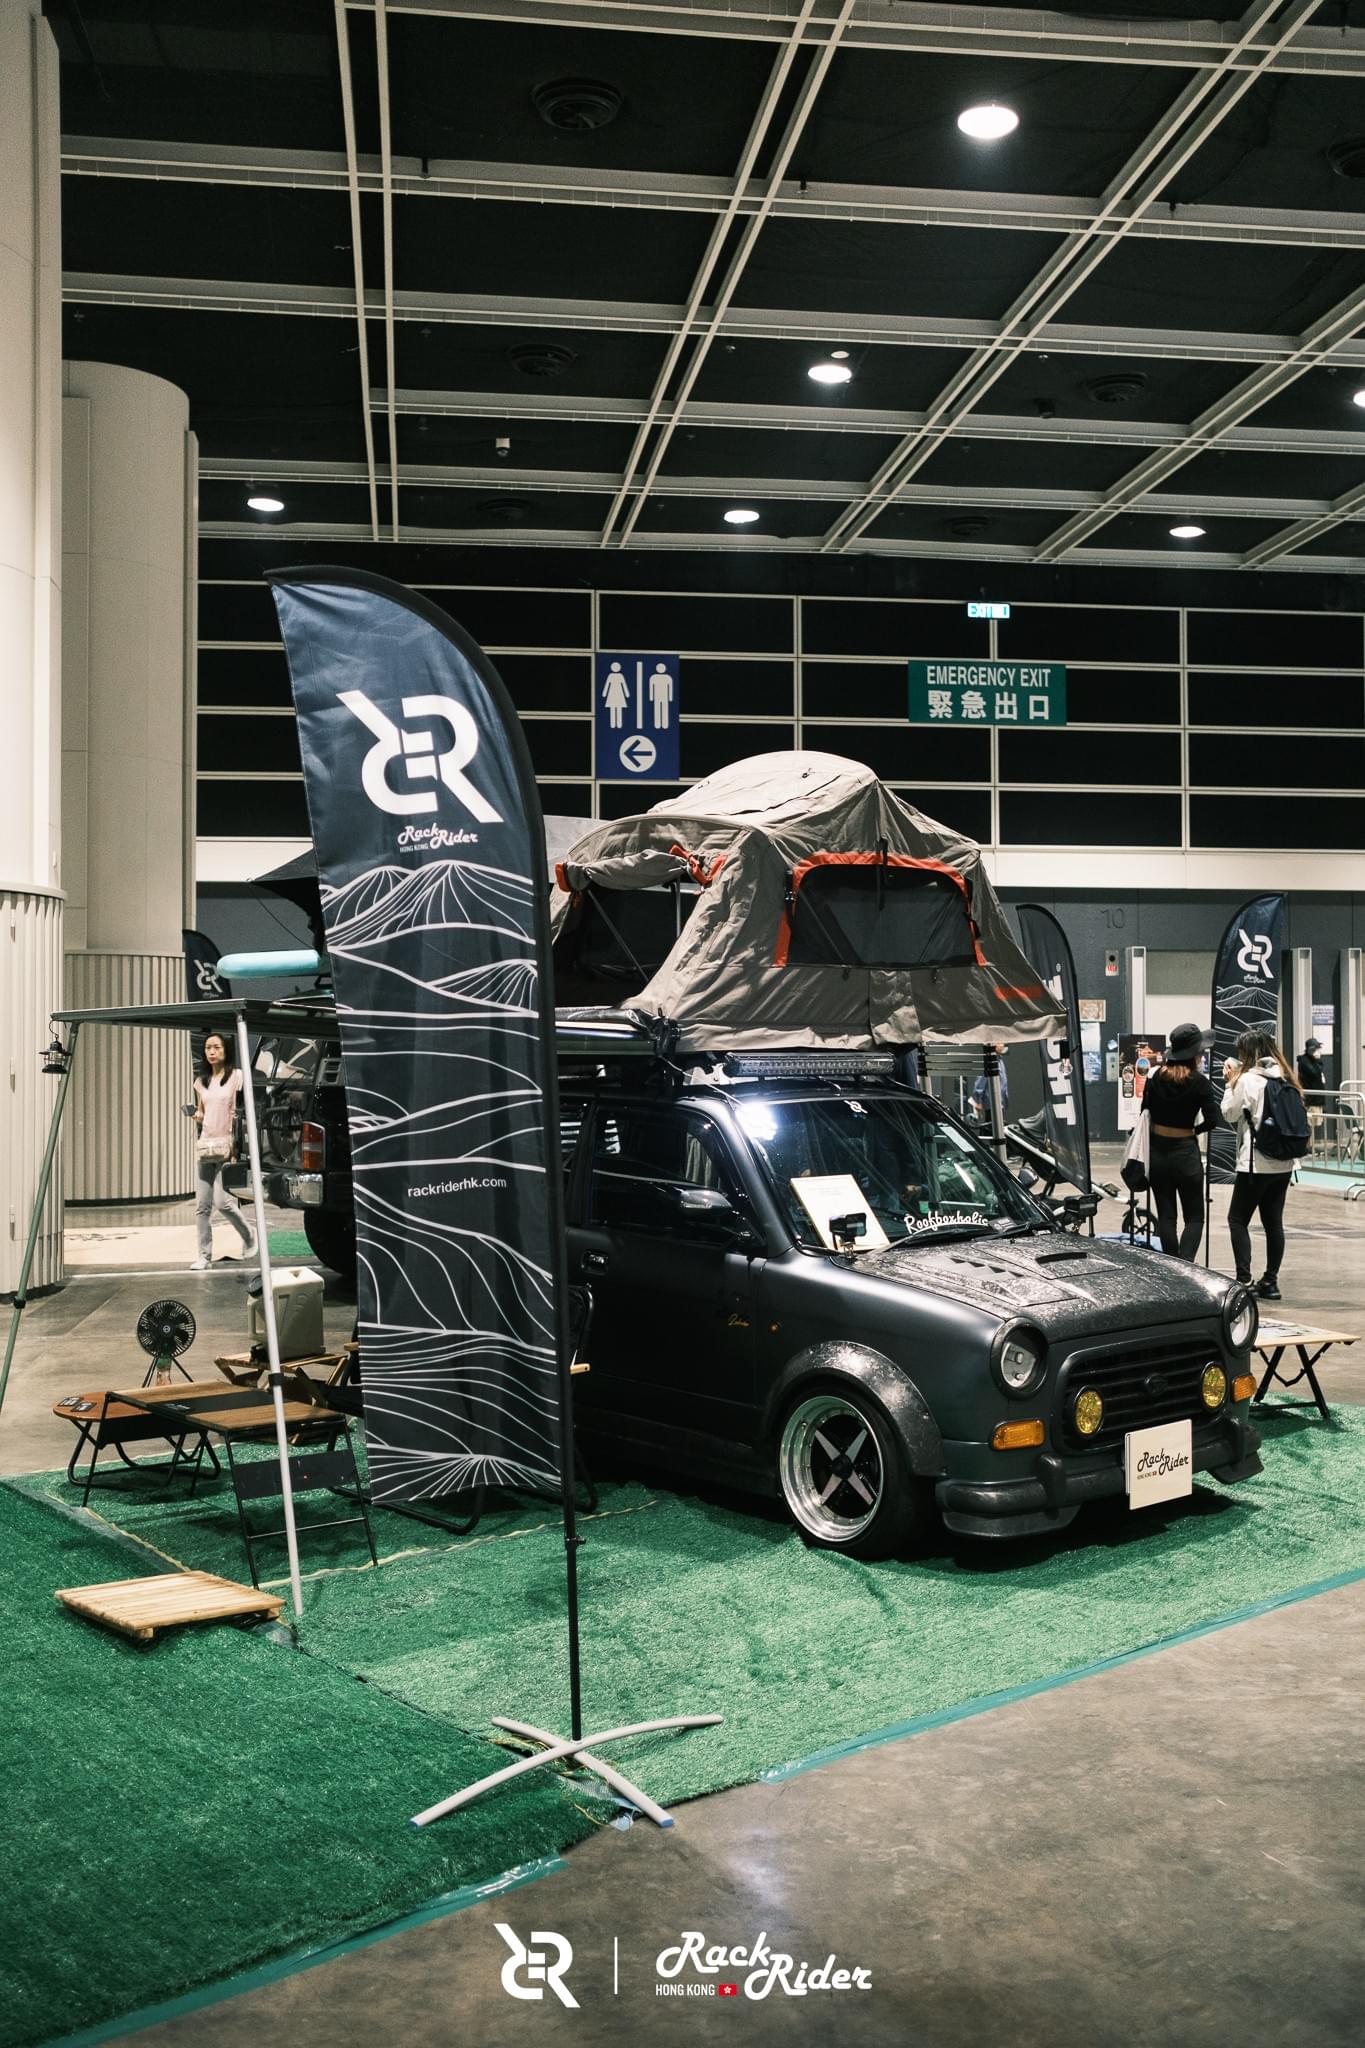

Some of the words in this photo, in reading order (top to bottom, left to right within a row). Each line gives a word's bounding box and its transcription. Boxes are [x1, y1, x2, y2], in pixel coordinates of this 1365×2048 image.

[927, 665, 1016, 687] EMERGENCY
[1020, 668, 1051, 688] EXIT
[927, 690, 1050, 720] 緊急出口
[397, 822, 439, 845] Rack
[430, 828, 479, 850] Rider
[1101, 908, 1125, 929] 10
[407, 1177, 507, 1197] rackriderhk.com
[903, 1210, 989, 1233] Roofboxholic
[1137, 1448, 1165, 1472] Rack
[1158, 1452, 1189, 1476] Rider
